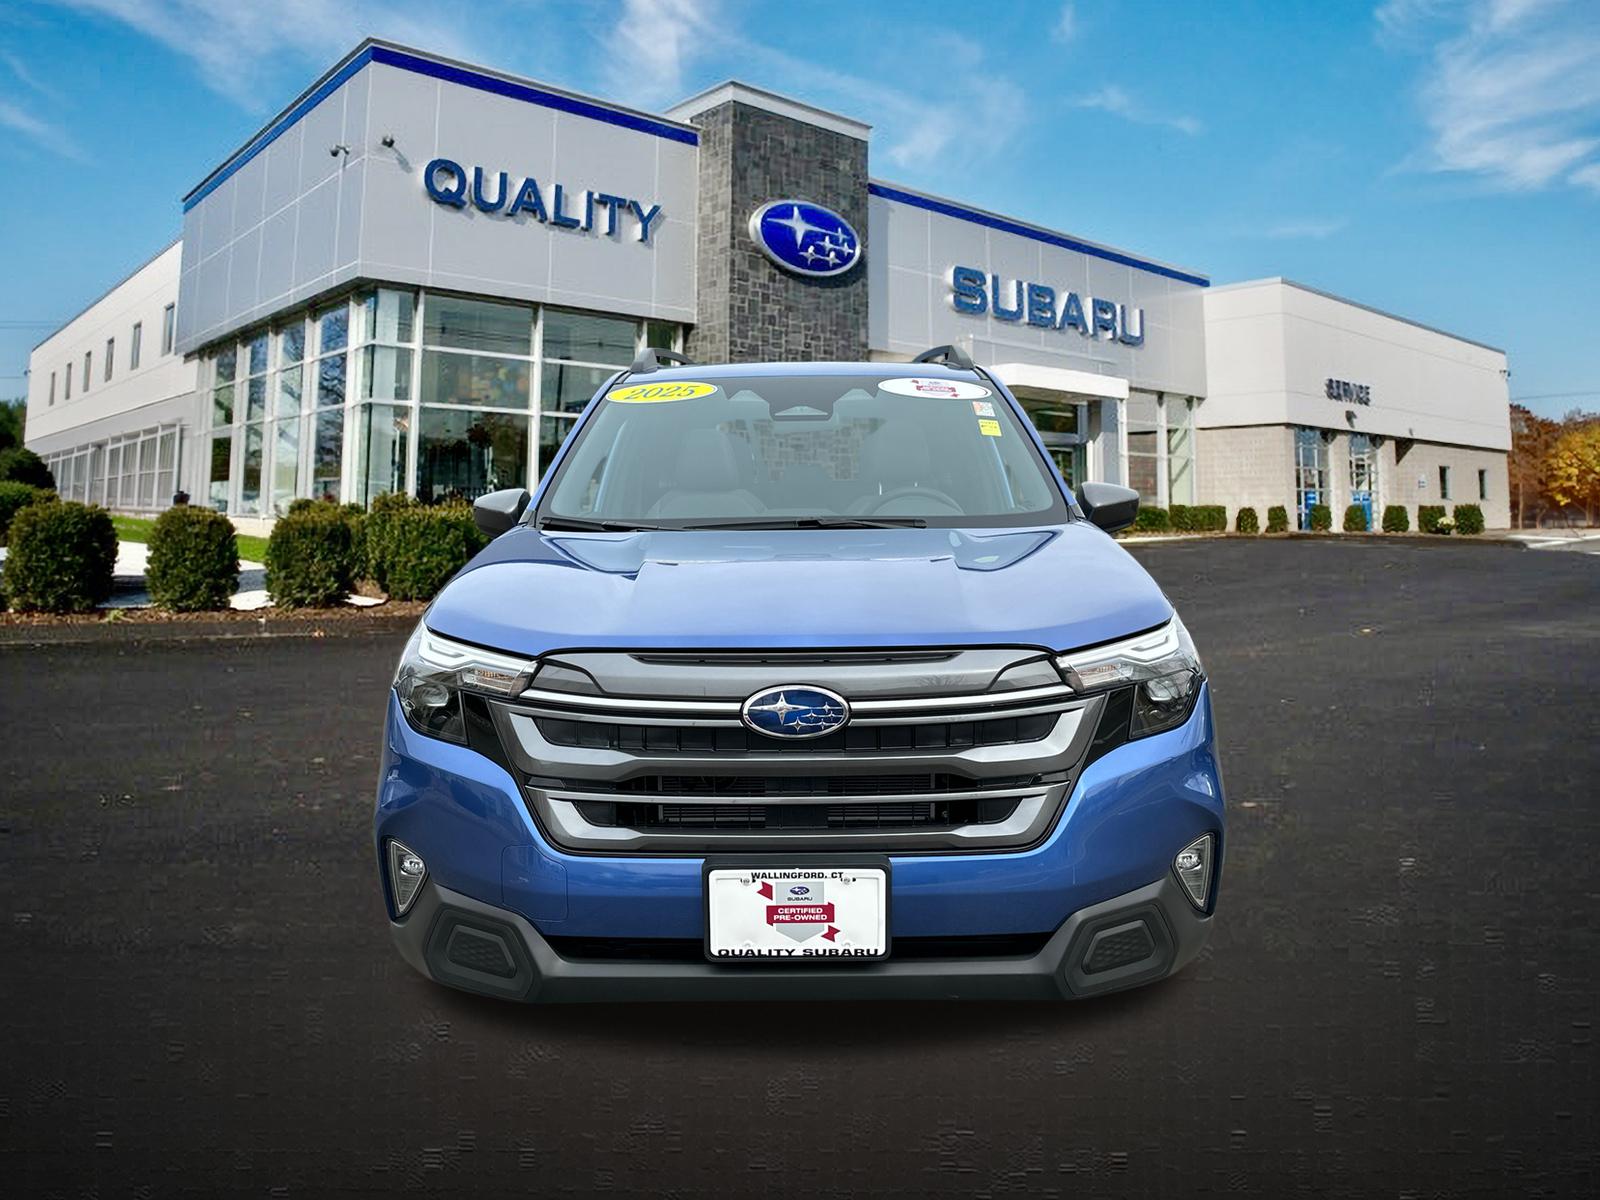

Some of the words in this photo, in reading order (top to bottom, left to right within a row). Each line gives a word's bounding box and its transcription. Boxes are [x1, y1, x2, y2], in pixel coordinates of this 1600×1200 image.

[424, 158, 661, 242] QUALITY
[952, 265, 1144, 347] SUBARU
[623, 385, 701, 400] 2025
[717, 949, 796, 957] QUALITY
[803, 949, 879, 957] SUBARU
